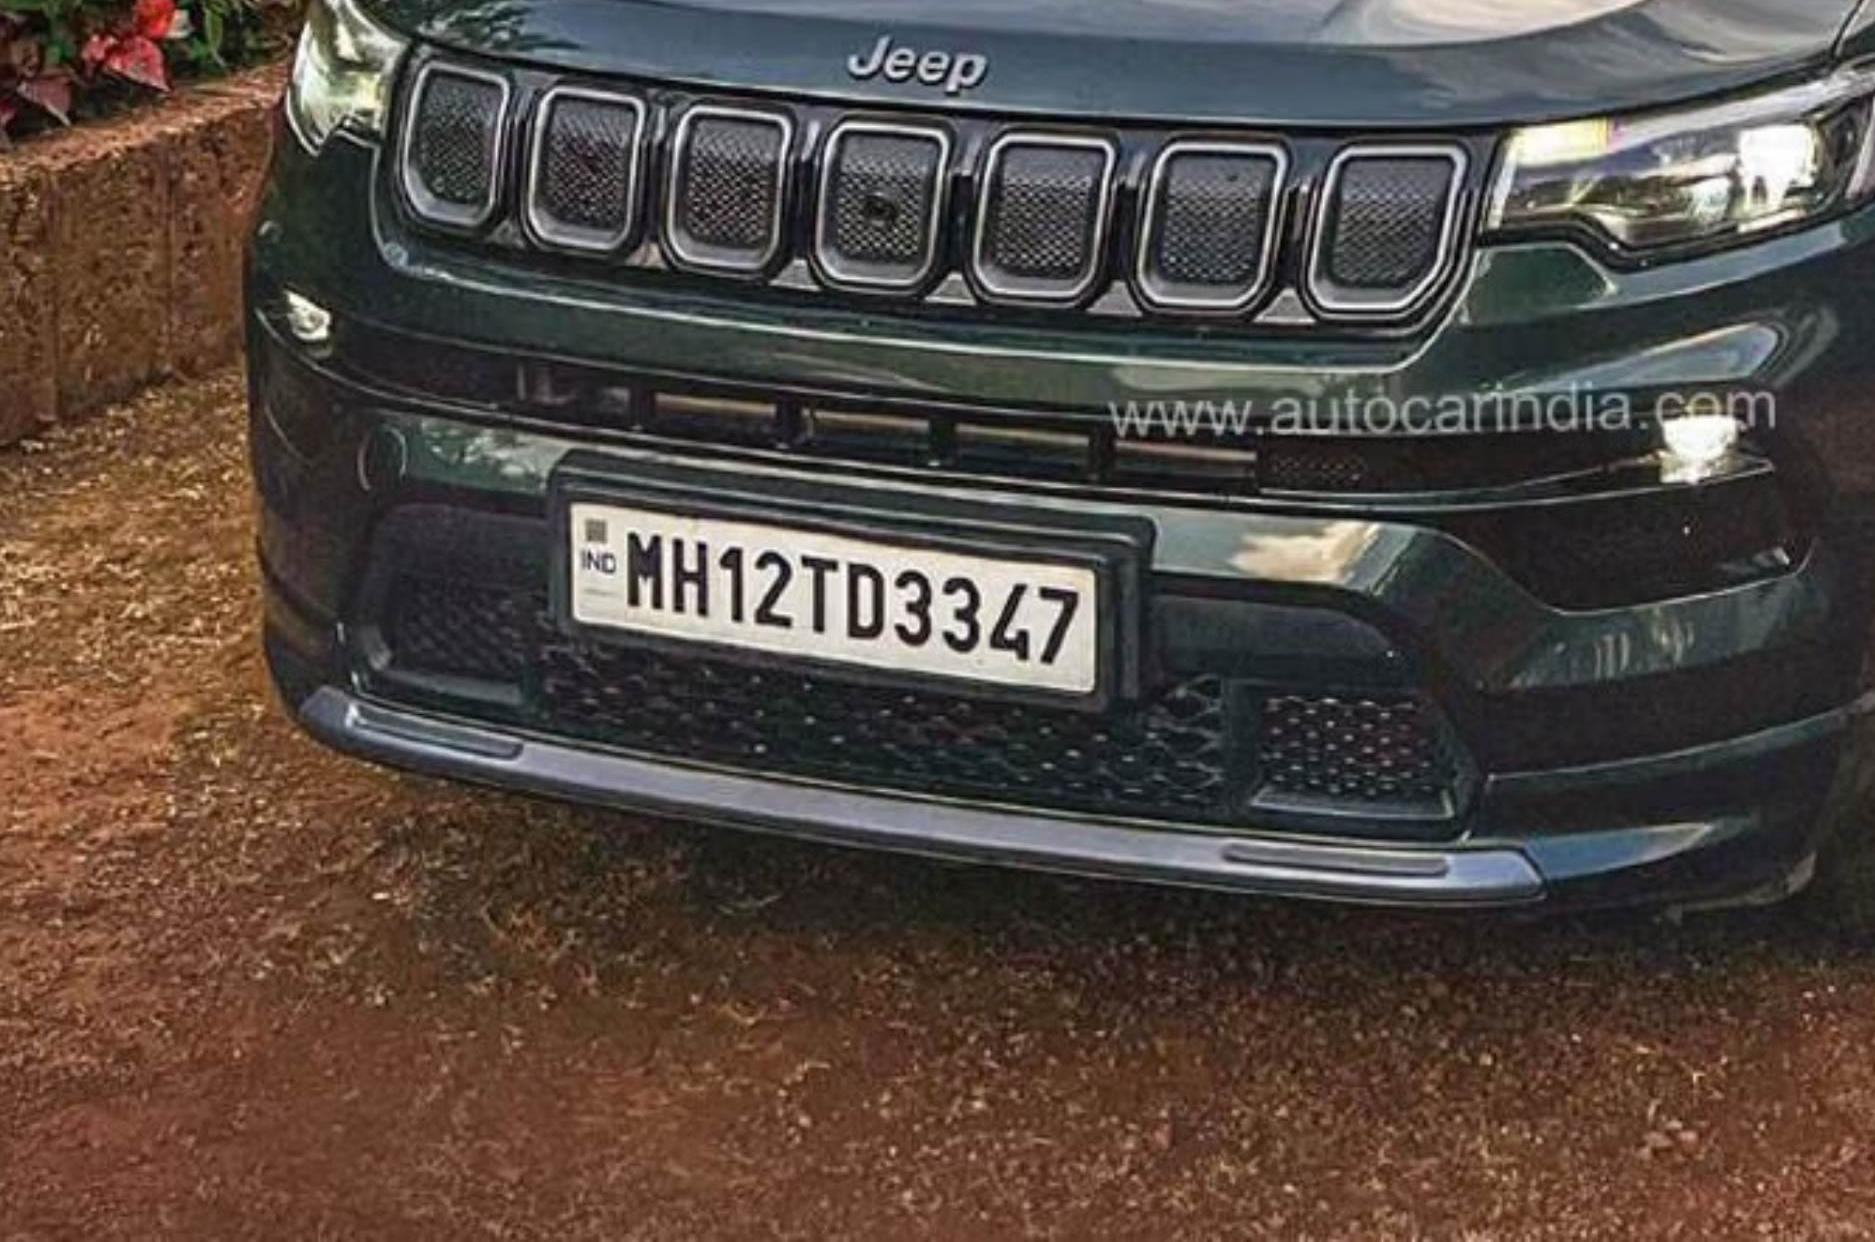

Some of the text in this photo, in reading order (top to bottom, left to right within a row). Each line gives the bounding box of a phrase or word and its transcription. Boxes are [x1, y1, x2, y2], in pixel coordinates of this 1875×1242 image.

[847, 35, 988, 95] Jeep
[581, 549, 616, 575] IND
[626, 531, 1079, 665] MH12TD3347
